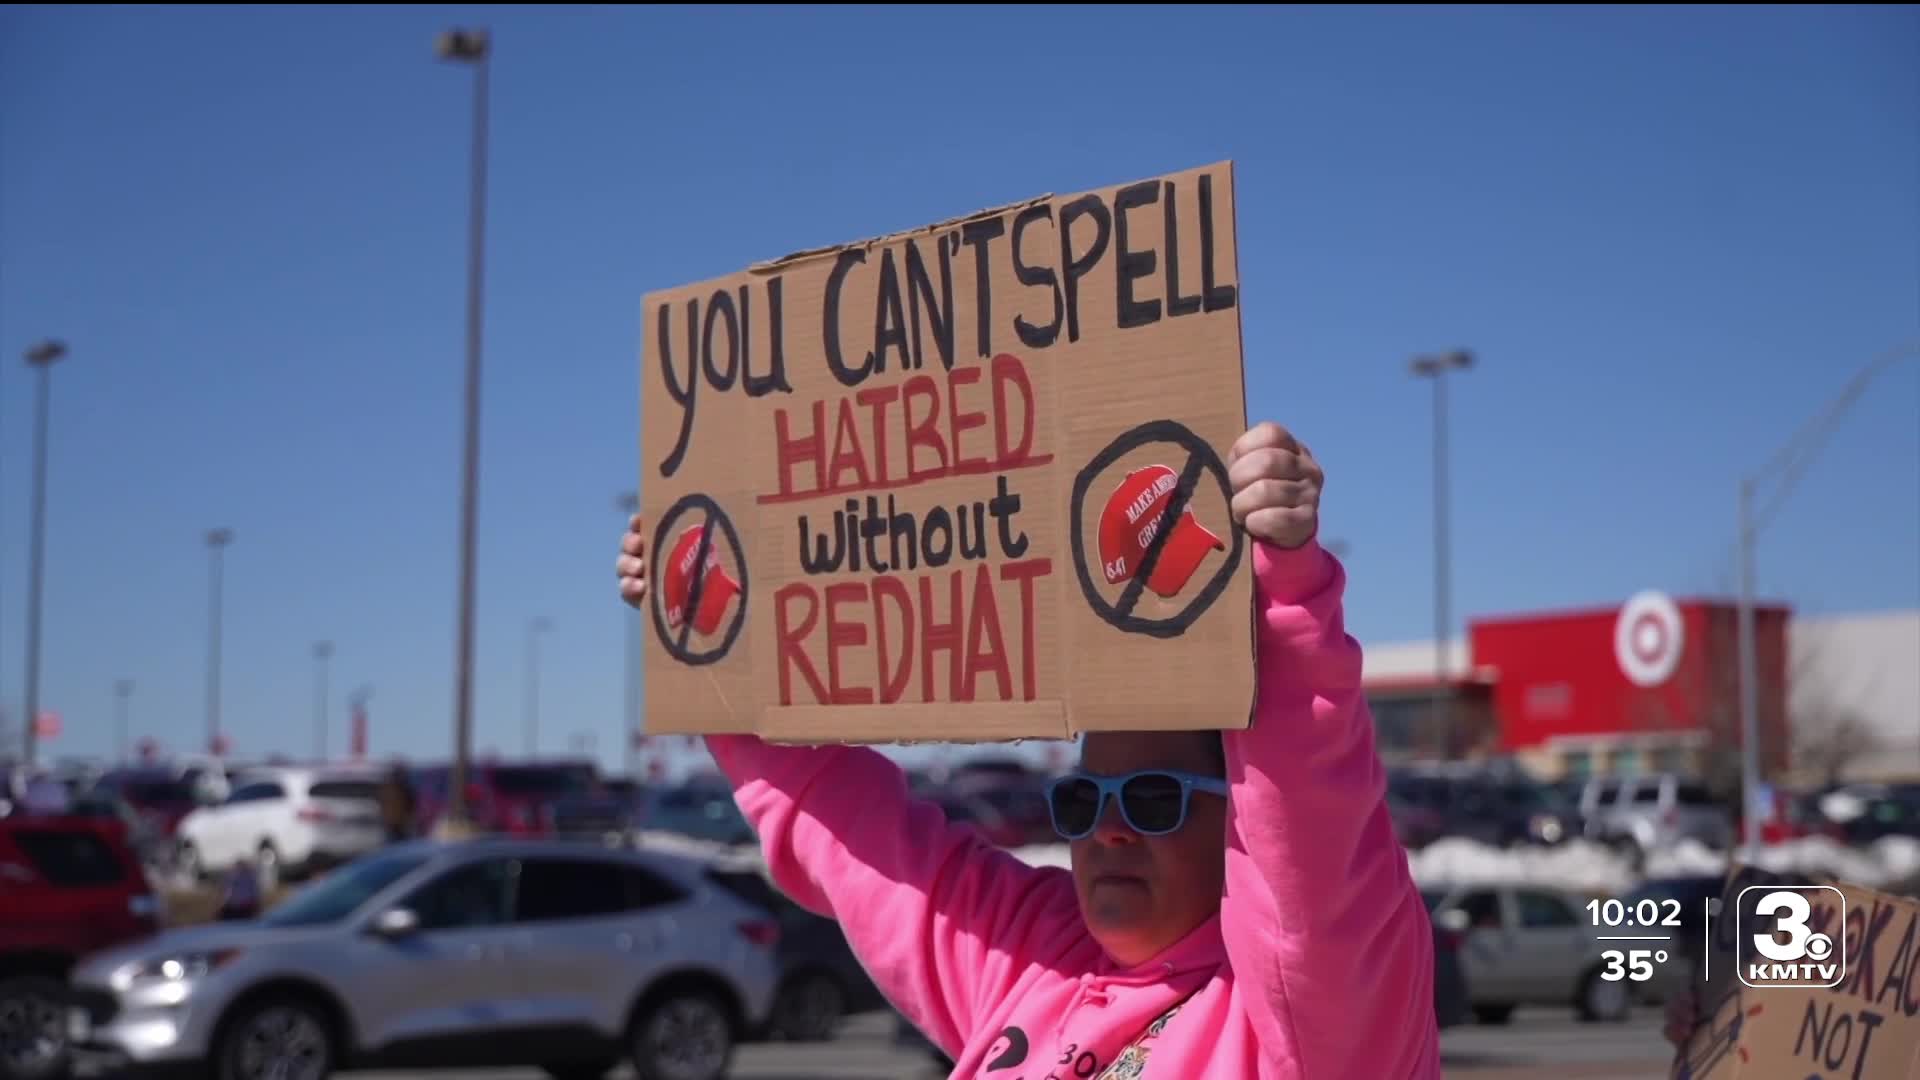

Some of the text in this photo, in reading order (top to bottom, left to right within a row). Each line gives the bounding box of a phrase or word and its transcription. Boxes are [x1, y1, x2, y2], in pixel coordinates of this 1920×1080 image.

[1011, 174, 1237, 349] SPELL
[774, 353, 1035, 496] HATRED
[798, 475, 1029, 576] without
[1793, 996, 1884, 1080] NOT
